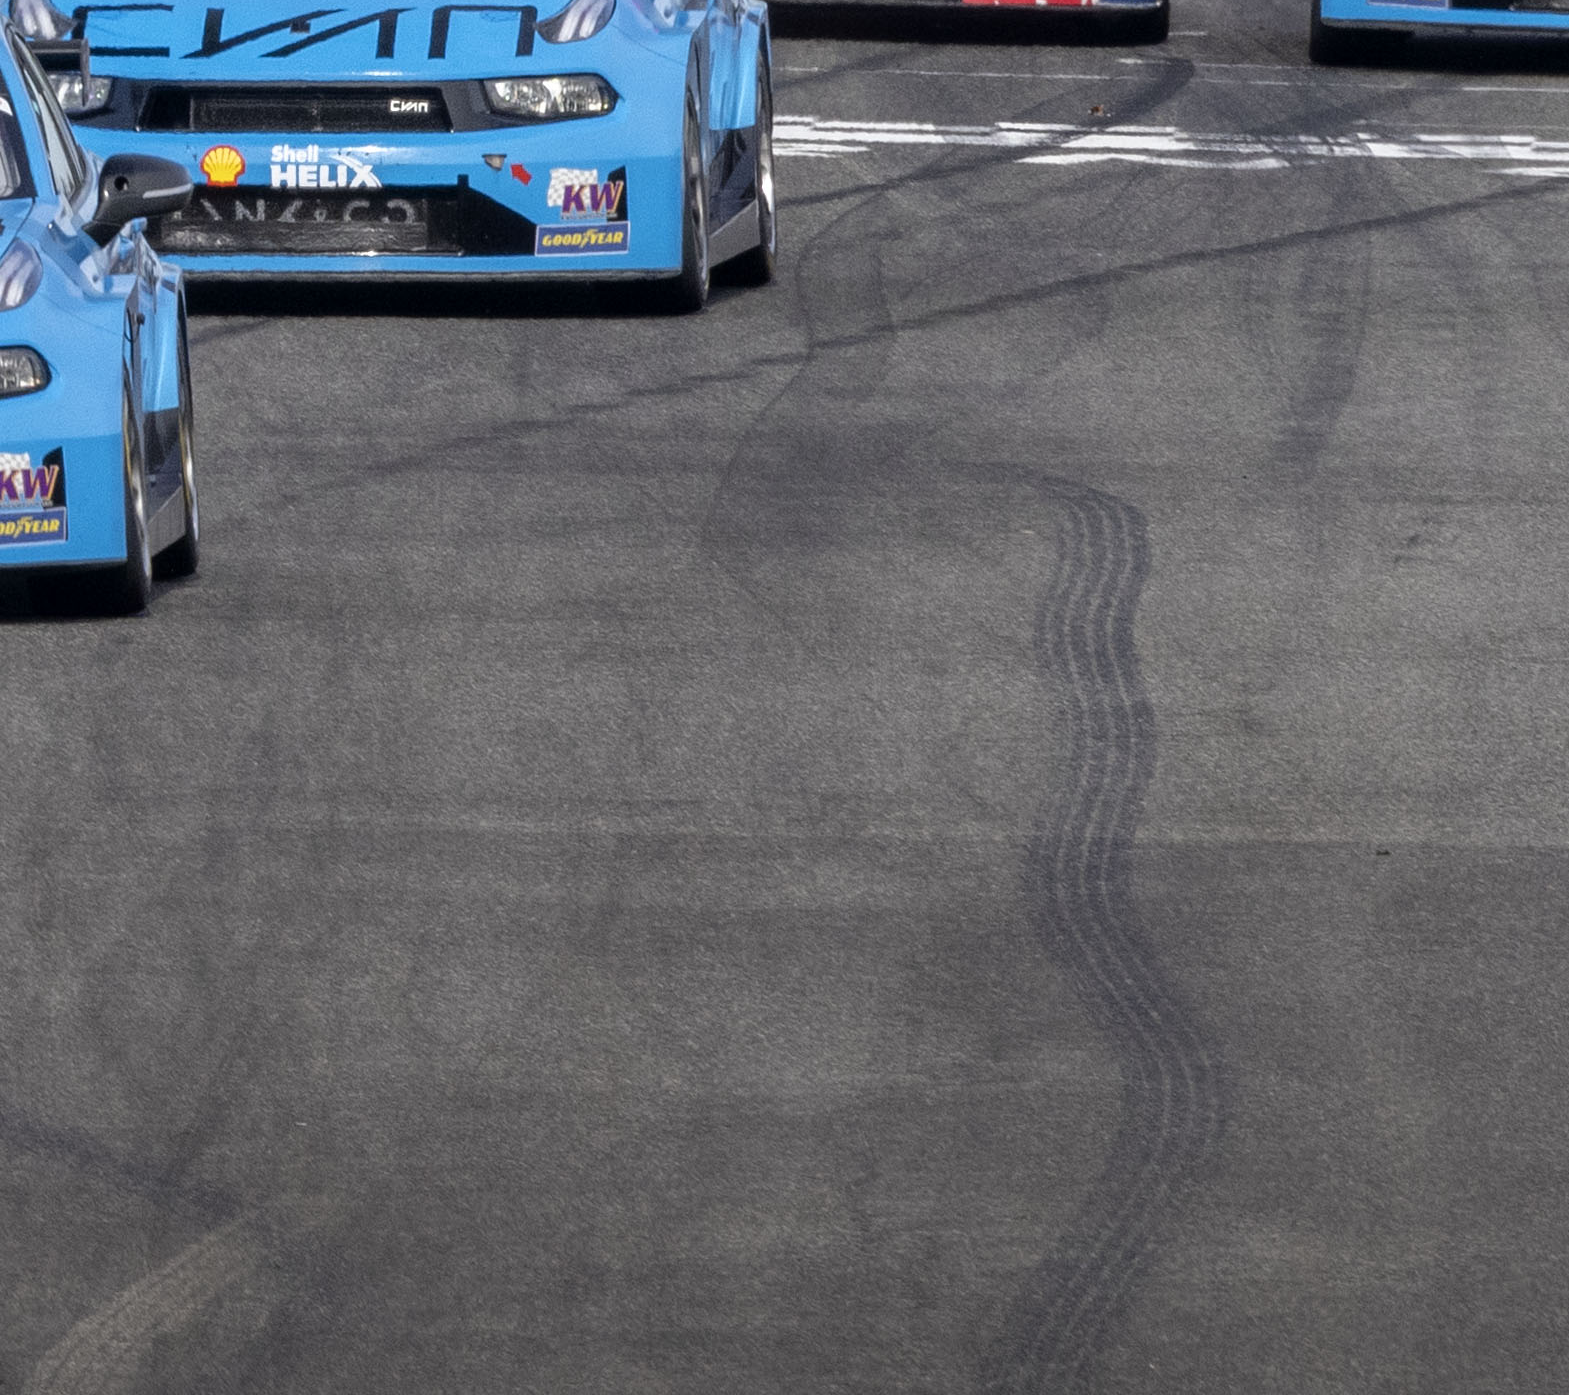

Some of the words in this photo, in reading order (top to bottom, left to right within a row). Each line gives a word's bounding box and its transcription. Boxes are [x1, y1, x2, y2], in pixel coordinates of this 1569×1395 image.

[270, 144, 321, 164] Shell
[270, 161, 385, 190] HELIX
[560, 179, 625, 215] KW
[540, 226, 626, 250] GOODYEAR
